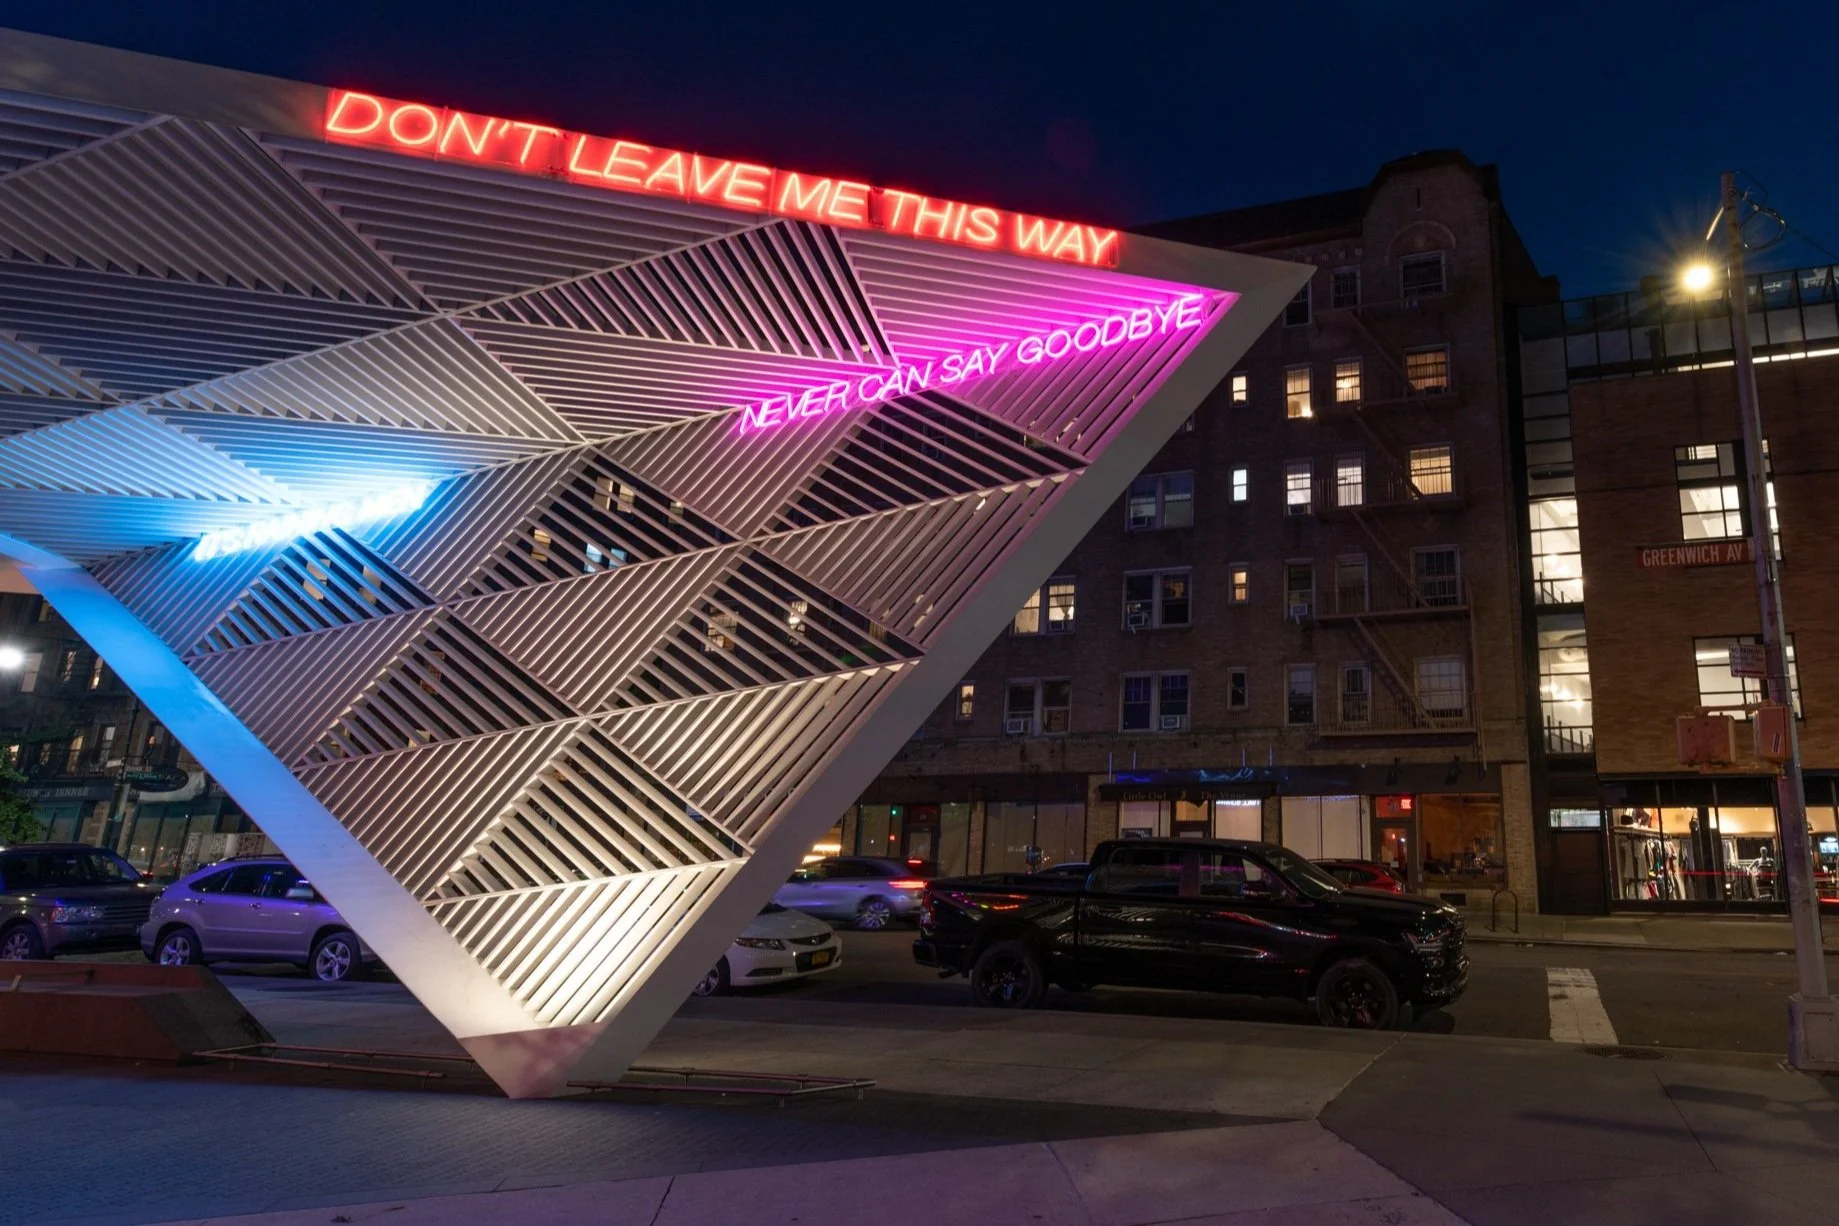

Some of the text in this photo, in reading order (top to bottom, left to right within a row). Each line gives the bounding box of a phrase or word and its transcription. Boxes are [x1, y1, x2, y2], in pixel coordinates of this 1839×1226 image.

[325, 90, 1118, 264] DON'T LEAVE ME THIS WAY
[739, 292, 1204, 434] NEVER CAN SAY GOODBYE
[1642, 544, 1743, 568] GREENWICH AV
